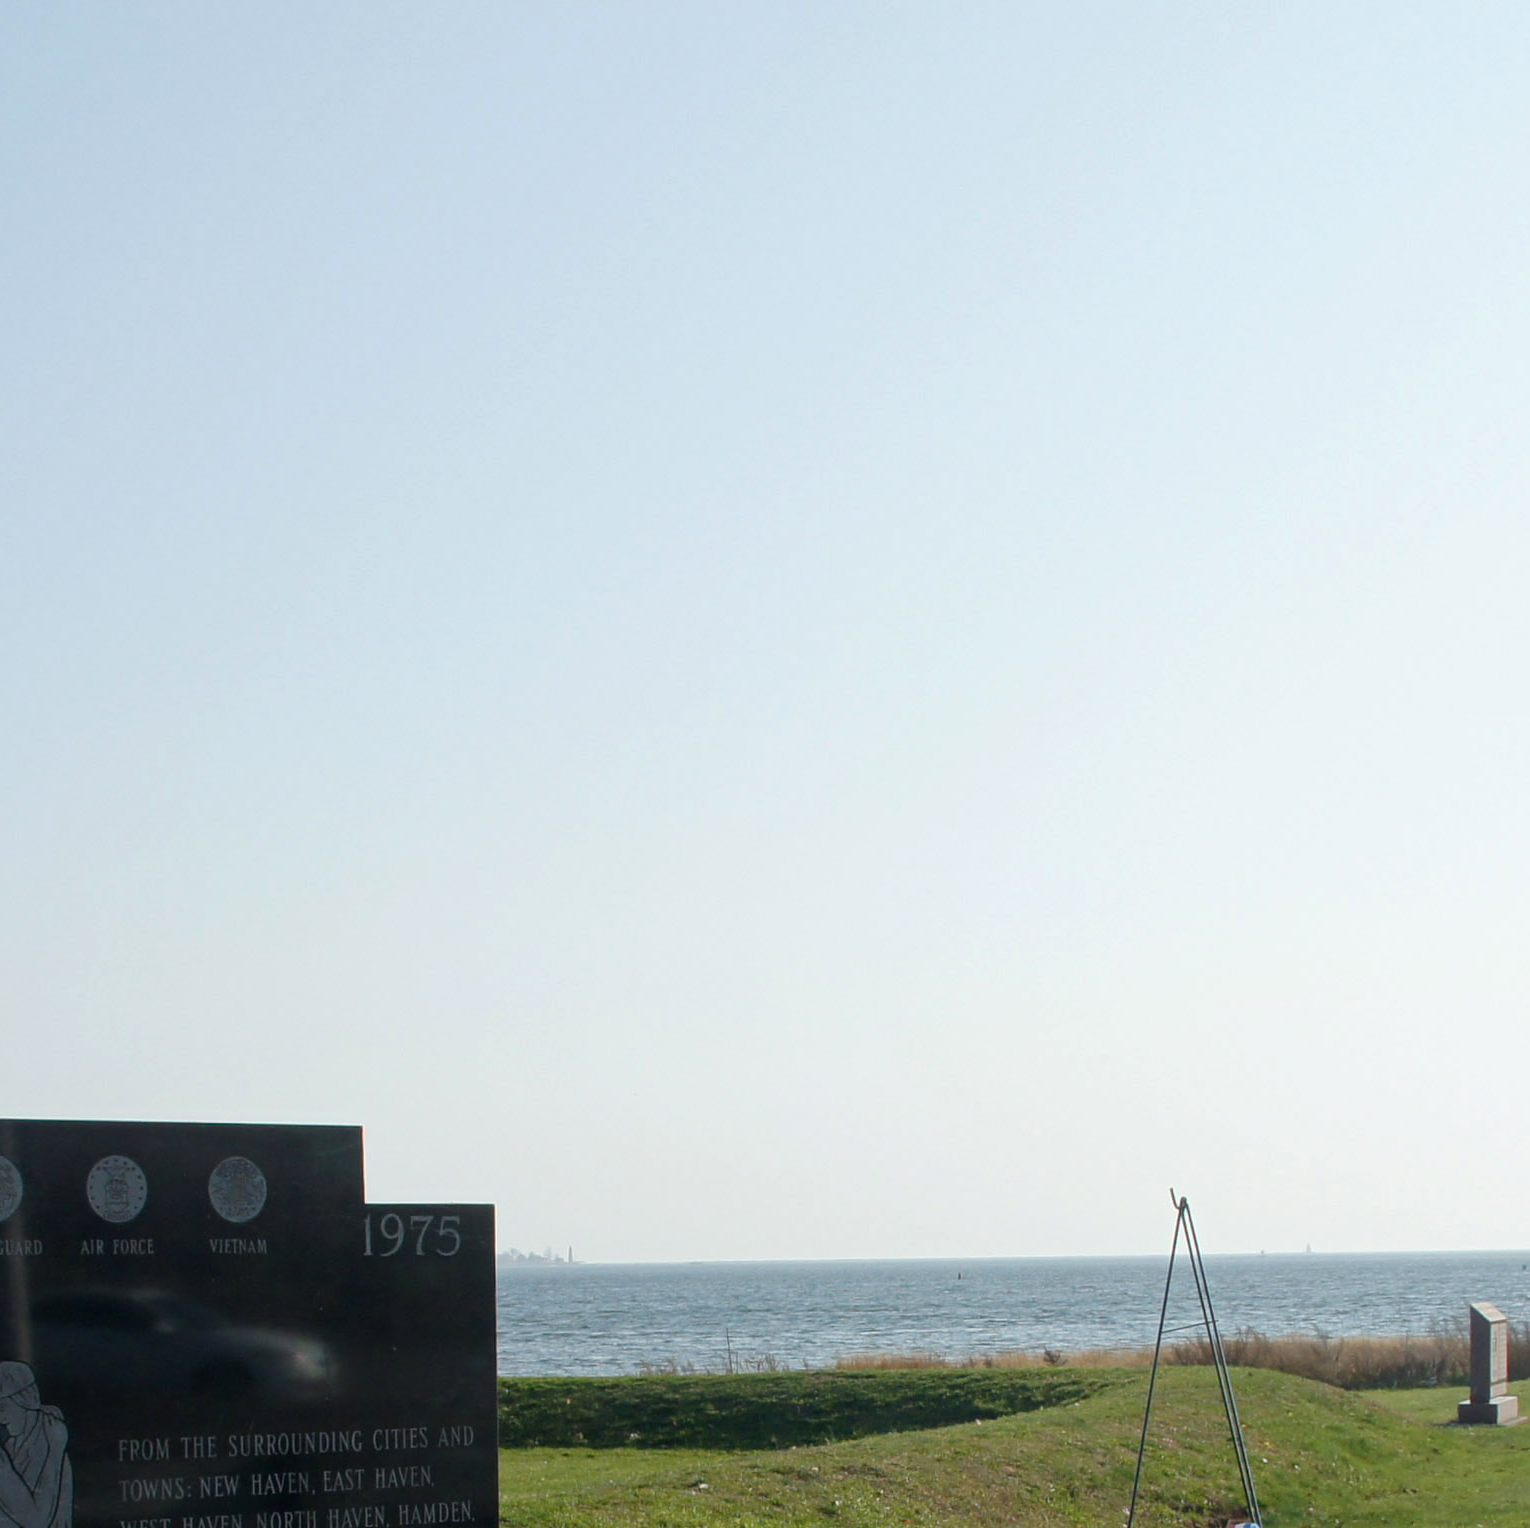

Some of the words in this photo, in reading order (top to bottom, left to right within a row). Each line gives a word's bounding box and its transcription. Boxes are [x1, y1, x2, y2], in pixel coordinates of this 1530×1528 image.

[81, 1239, 104, 1254] AIR
[113, 1239, 154, 1255] FORCE
[209, 1238, 267, 1254] VIETNAM
[364, 1214, 460, 1257] 1975
[119, 1438, 169, 1461] FROM
[180, 1436, 216, 1458] THE
[229, 1430, 362, 1457] SURROUNDING
[373, 1427, 428, 1451] CITIES
[438, 1426, 474, 1447] AND
[119, 1477, 191, 1502] TOWNS:
[200, 1476, 239, 1498] NEW
[252, 1472, 315, 1495] HAVEN,
[323, 1469, 364, 1492] EAST
[375, 1466, 434, 1489] HAVEN,
